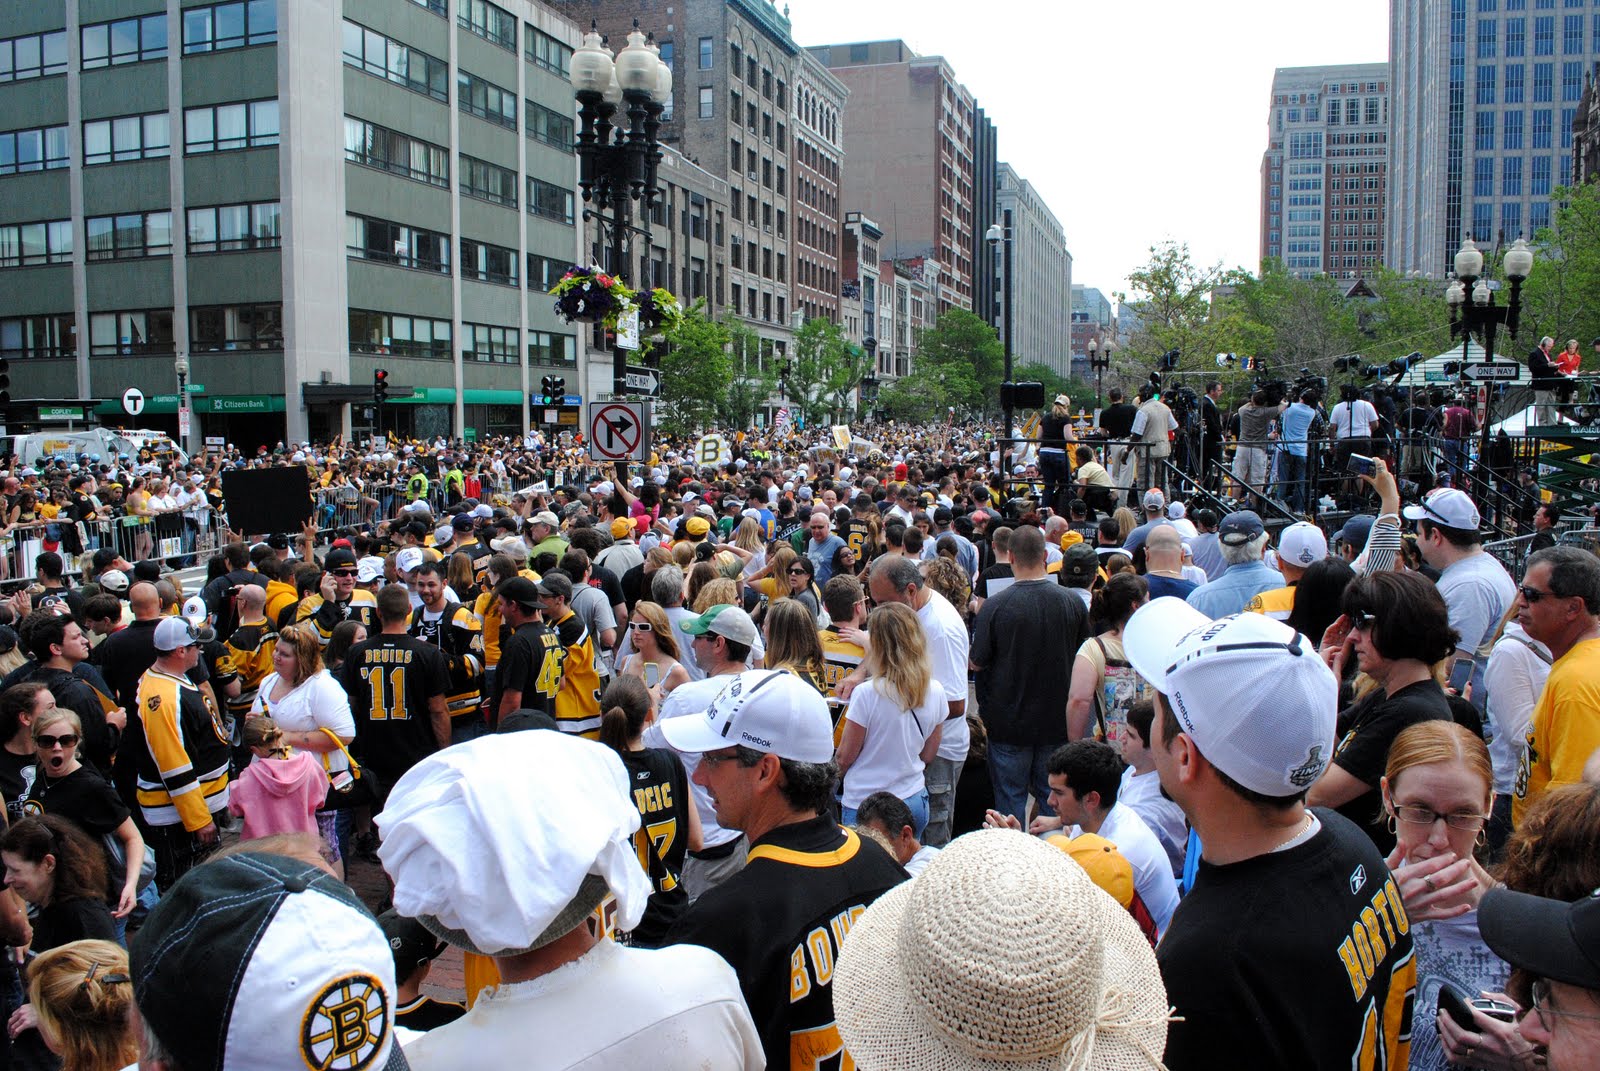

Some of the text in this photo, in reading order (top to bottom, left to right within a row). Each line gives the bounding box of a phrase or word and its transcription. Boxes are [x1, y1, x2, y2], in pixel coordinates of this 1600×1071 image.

[1477, 367, 1514, 375] ONE WAY
[626, 374, 649, 388] ONE WAY
[127, 395, 142, 411] T
[223, 400, 264, 408] Citizens Bank
[701, 438, 720, 463] B
[365, 648, 413, 664] BRUINS
[1174, 690, 1195, 734] Reebok
[741, 731, 772, 748] Reebok
[633, 781, 674, 815] UCIC
[1336, 878, 1410, 1003] HORTO
[326, 996, 370, 1060] B
